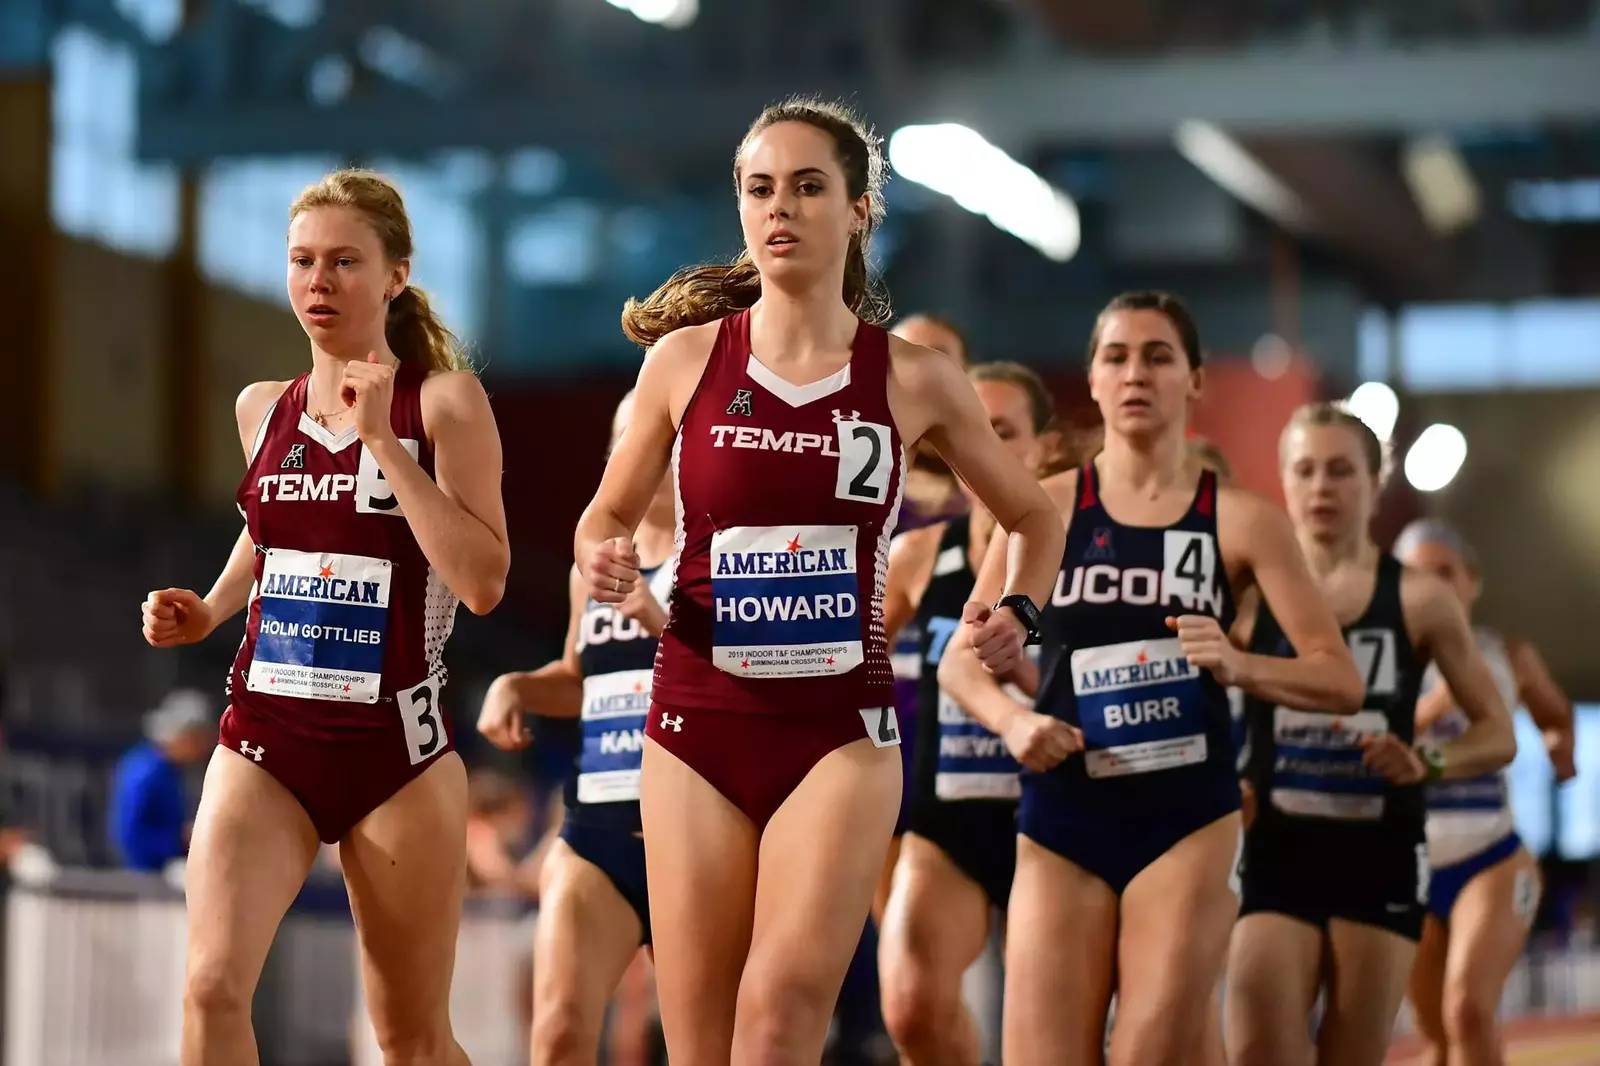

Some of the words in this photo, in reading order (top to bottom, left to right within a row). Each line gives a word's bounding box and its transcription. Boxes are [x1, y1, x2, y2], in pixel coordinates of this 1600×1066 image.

[848, 426, 882, 499] 2
[257, 473, 359, 503] TEMP
[716, 548, 847, 575] AMERICAN
[1175, 538, 1206, 593] 4
[264, 573, 380, 604] AMERICAN
[716, 592, 857, 622] HOWARD
[260, 619, 298, 638] HOLM
[301, 624, 381, 645] GOTTLIEB
[728, 650, 744, 659] 2019
[745, 649, 773, 658] INDOOR
[775, 649, 788, 657] T&F
[790, 646, 848, 657] CHAMPIONSHIPS
[751, 658, 790, 667] BIRMINGHAM
[790, 657, 826, 666] CROSSPLEX
[1359, 636, 1384, 687] 7
[274, 667, 296, 677] INDOOR
[297, 670, 308, 678] T&F
[309, 672, 365, 684] CHAMPIONSHIPS
[277, 677, 308, 687] BIRMINGHAM
[308, 681, 343, 690] CROSSPLEX
[1081, 656, 1190, 691] AMERICAN
[411, 685, 439, 757] 3
[1103, 697, 1181, 729] BURR
